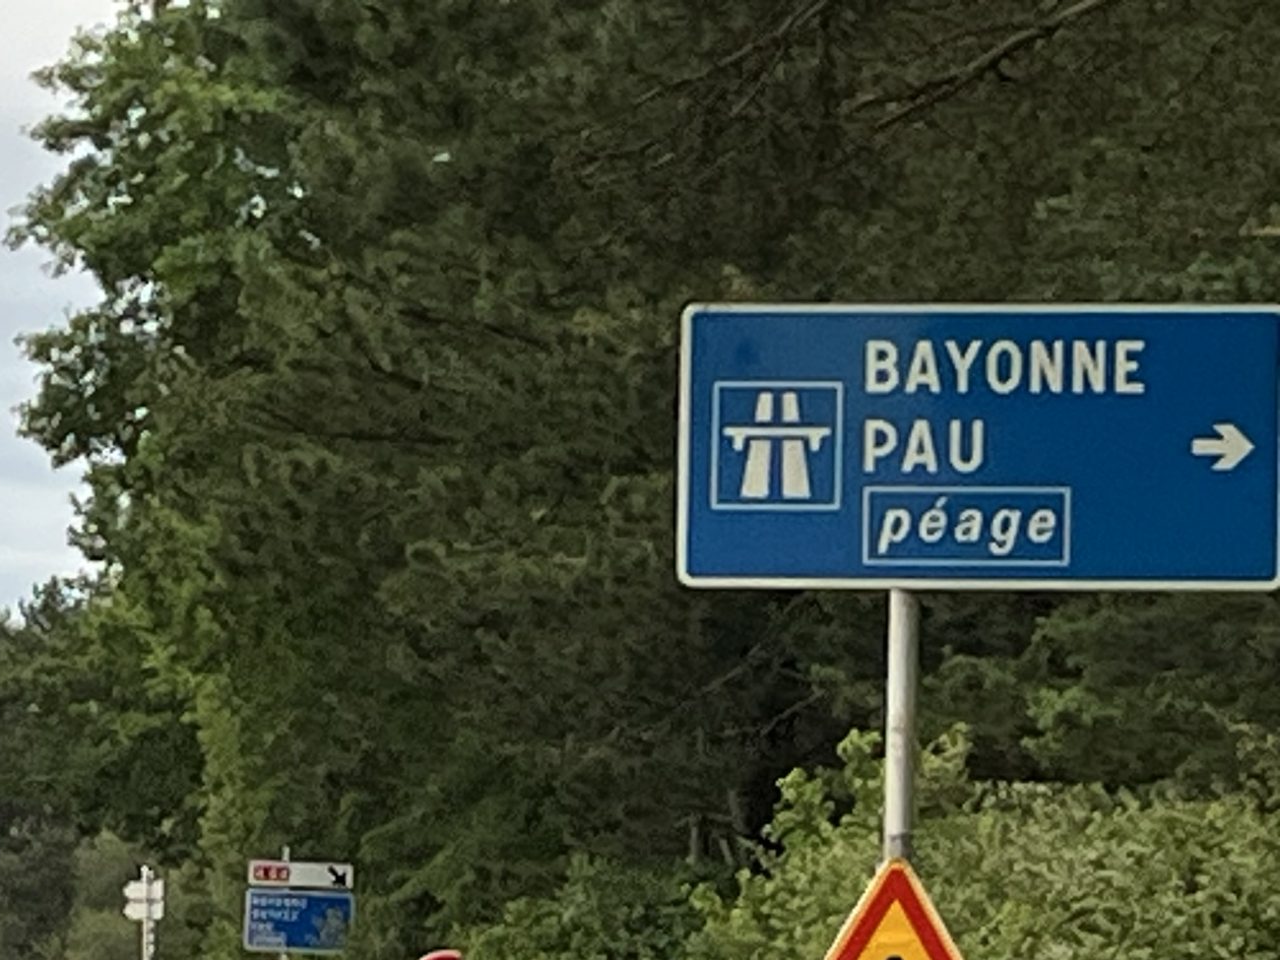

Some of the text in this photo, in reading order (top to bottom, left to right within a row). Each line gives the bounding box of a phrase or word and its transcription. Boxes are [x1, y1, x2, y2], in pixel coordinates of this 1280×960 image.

[863, 339, 1146, 395] BAYONNE
[862, 418, 985, 474] PAU
[876, 495, 1058, 556] péage
